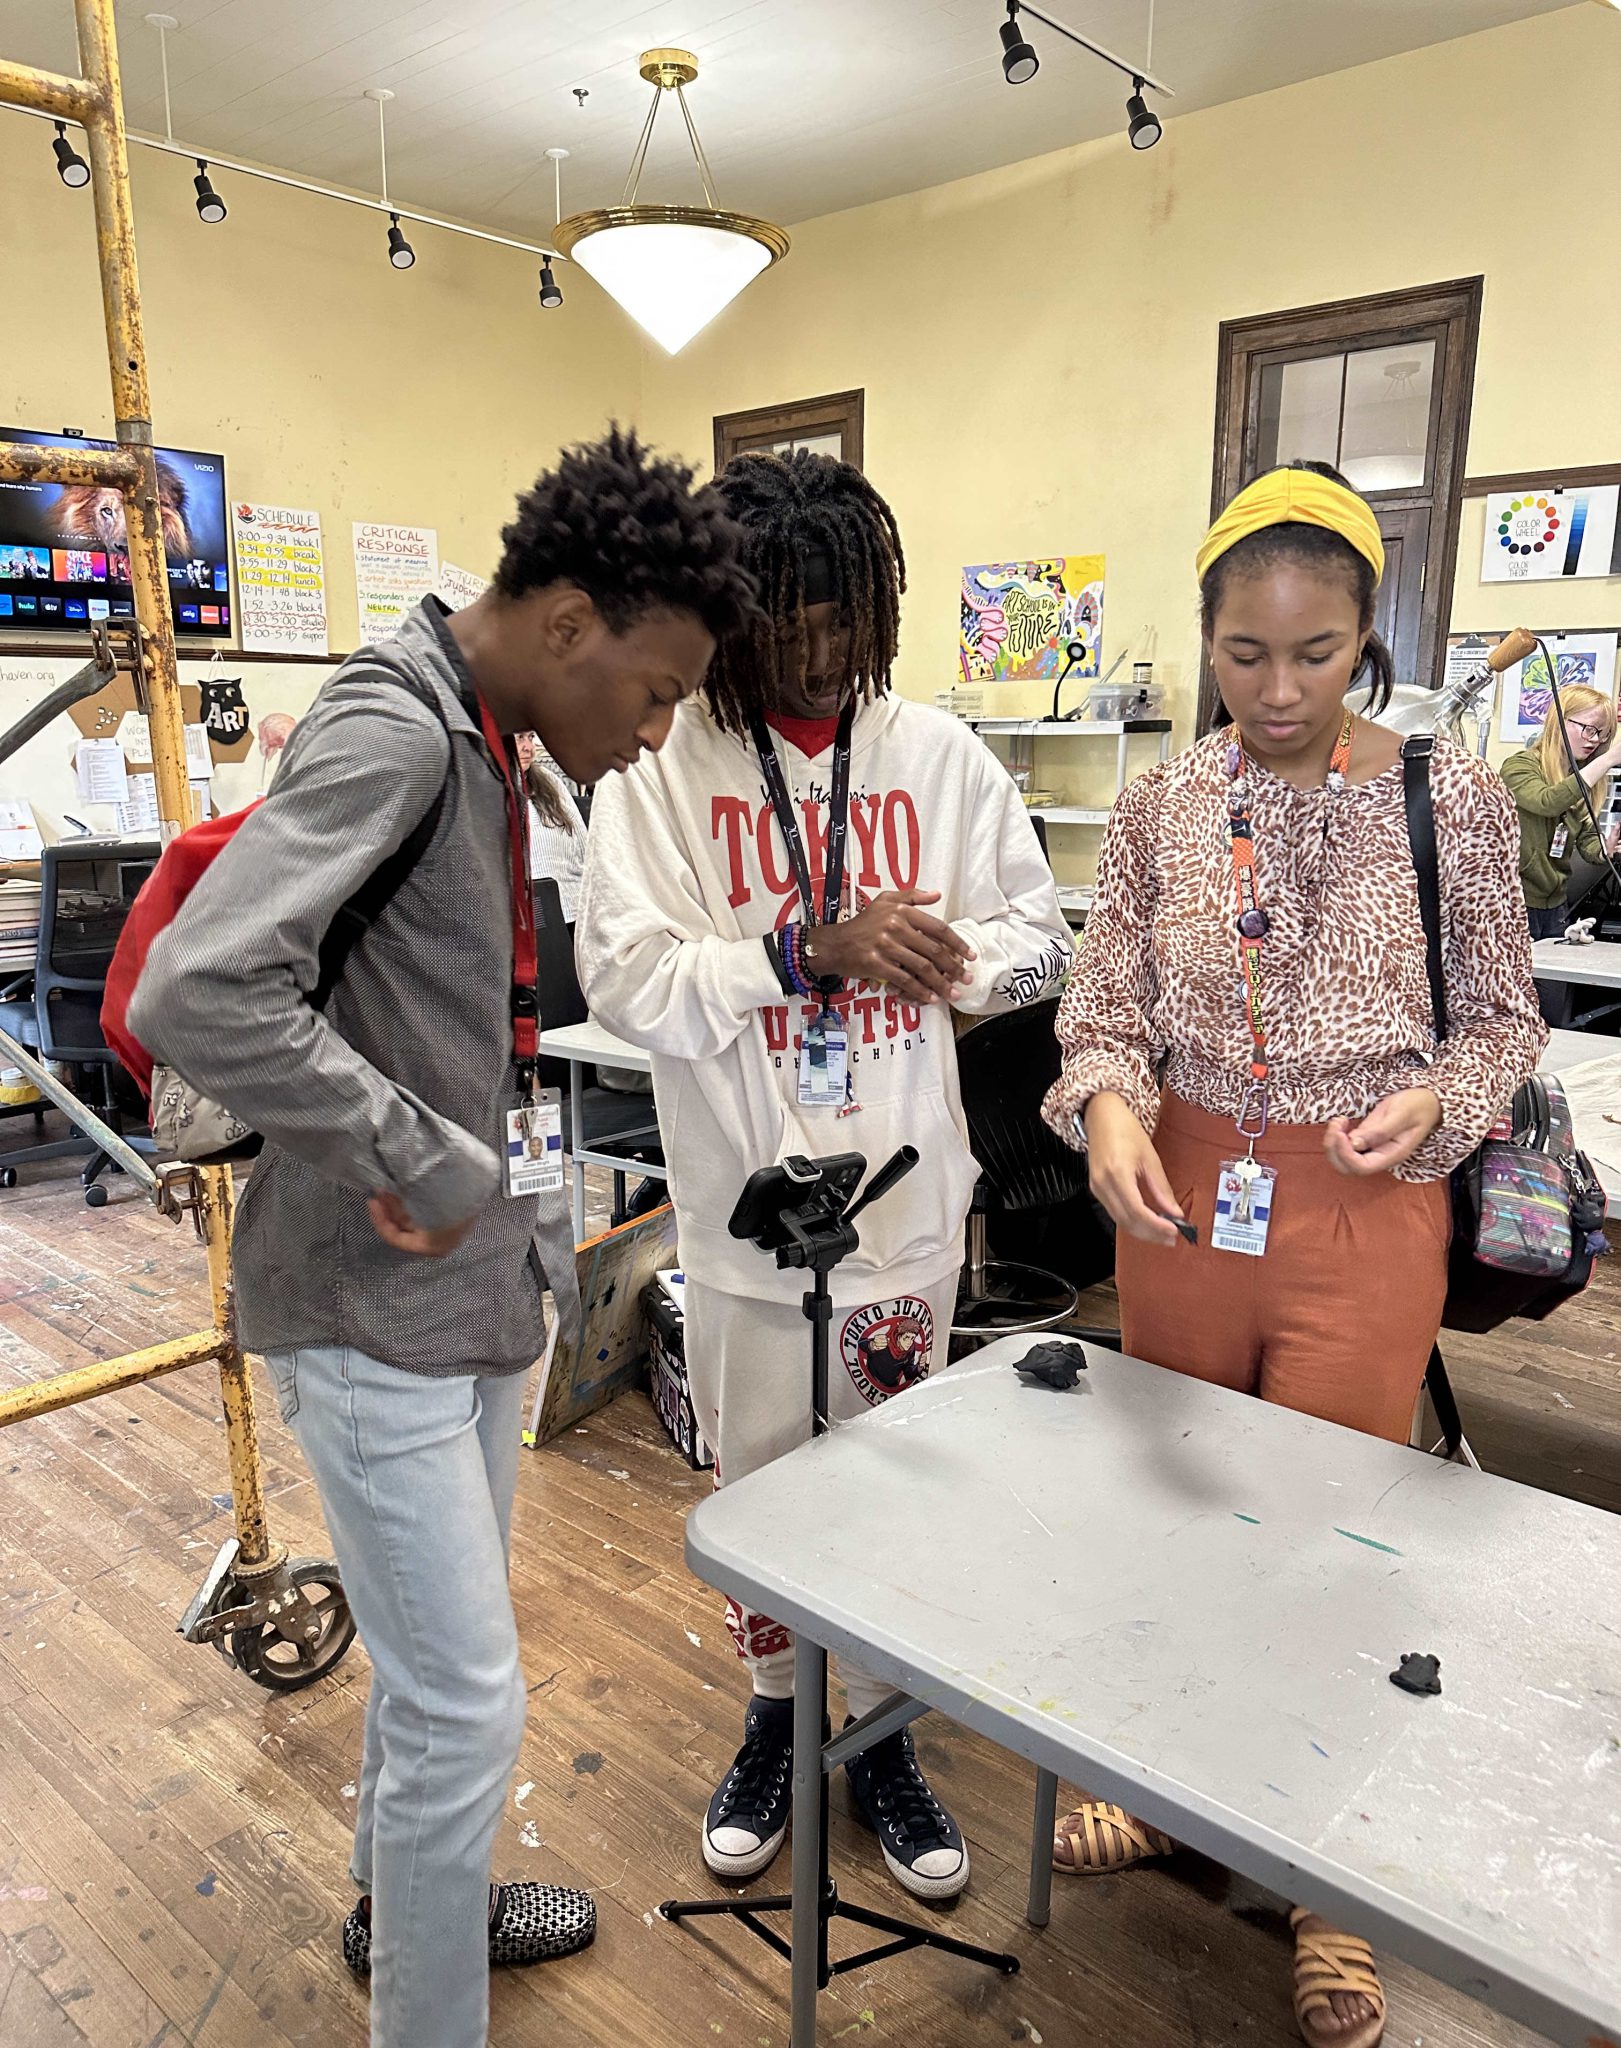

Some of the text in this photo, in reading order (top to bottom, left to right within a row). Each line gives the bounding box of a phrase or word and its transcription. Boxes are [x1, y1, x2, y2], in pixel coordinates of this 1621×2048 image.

[194, 463, 214, 473] VIZIO
[257, 508, 314, 526] SCHEDULE
[1516, 519, 1540, 529] COLOR
[362, 526, 424, 541] CRITICAL
[1516, 527, 1540, 538] WHEEL
[293, 548, 317, 560] break
[357, 538, 430, 554] RESPONSE
[294, 575, 316, 586] lunch
[18, 602, 35, 610] hulu
[1002, 591, 1024, 613] ART
[1017, 595, 1041, 613] SCHOOL
[1009, 612, 1057, 657] FUTURE
[205, 702, 248, 732] ART
[711, 789, 921, 909] TOKYO
[844, 1304, 885, 1350] TOKYO
[847, 1357, 888, 1405] CHOOL
